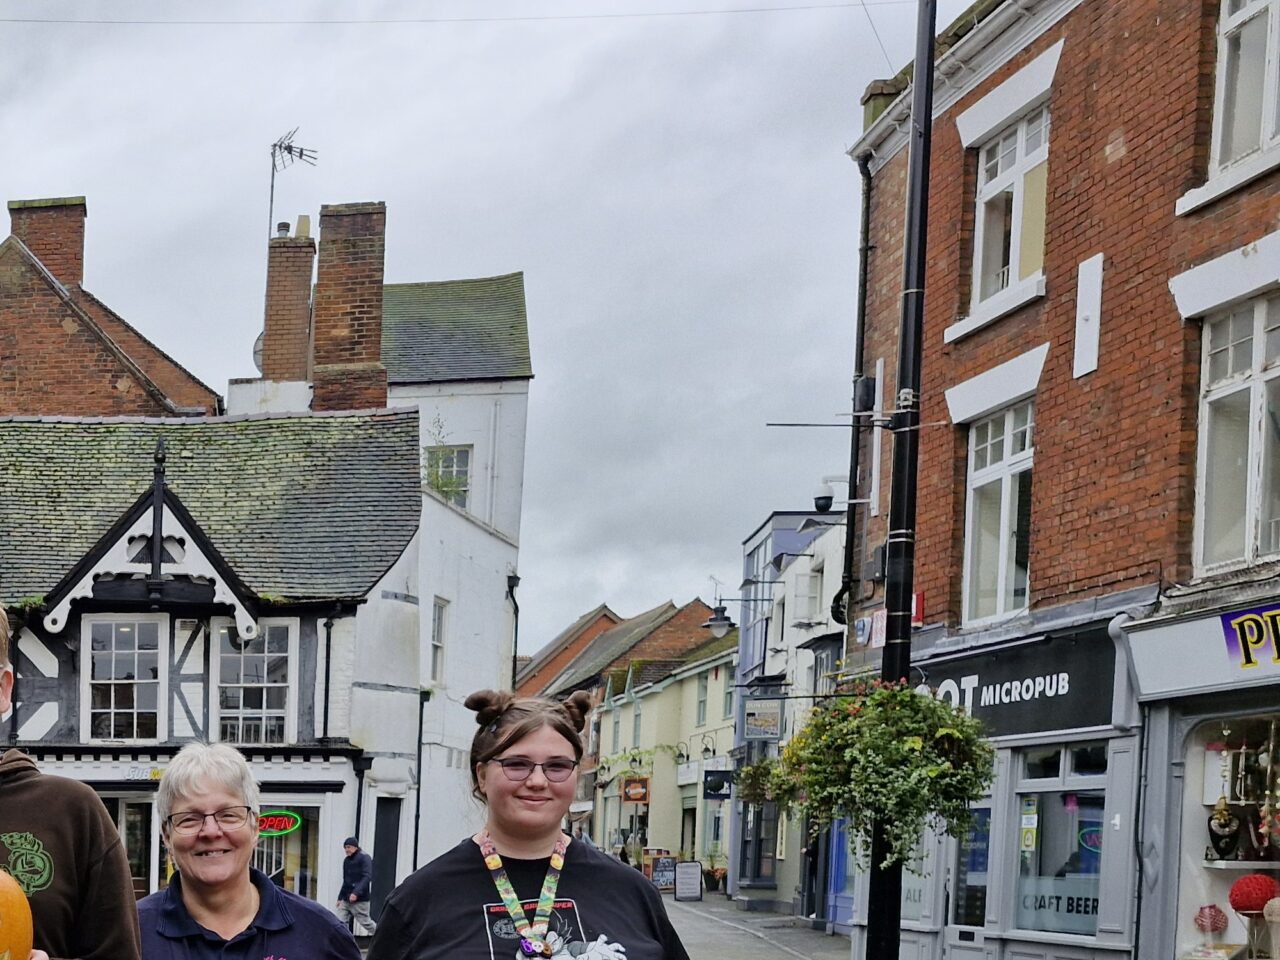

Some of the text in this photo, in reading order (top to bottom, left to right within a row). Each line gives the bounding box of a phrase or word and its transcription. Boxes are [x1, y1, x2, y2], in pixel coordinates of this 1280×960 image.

[915, 672, 1069, 718] OT MICROPUB
[128, 768, 161, 780] SUBW
[257, 817, 296, 831] OPEN
[1023, 895, 1099, 915] CRAFT BEER
